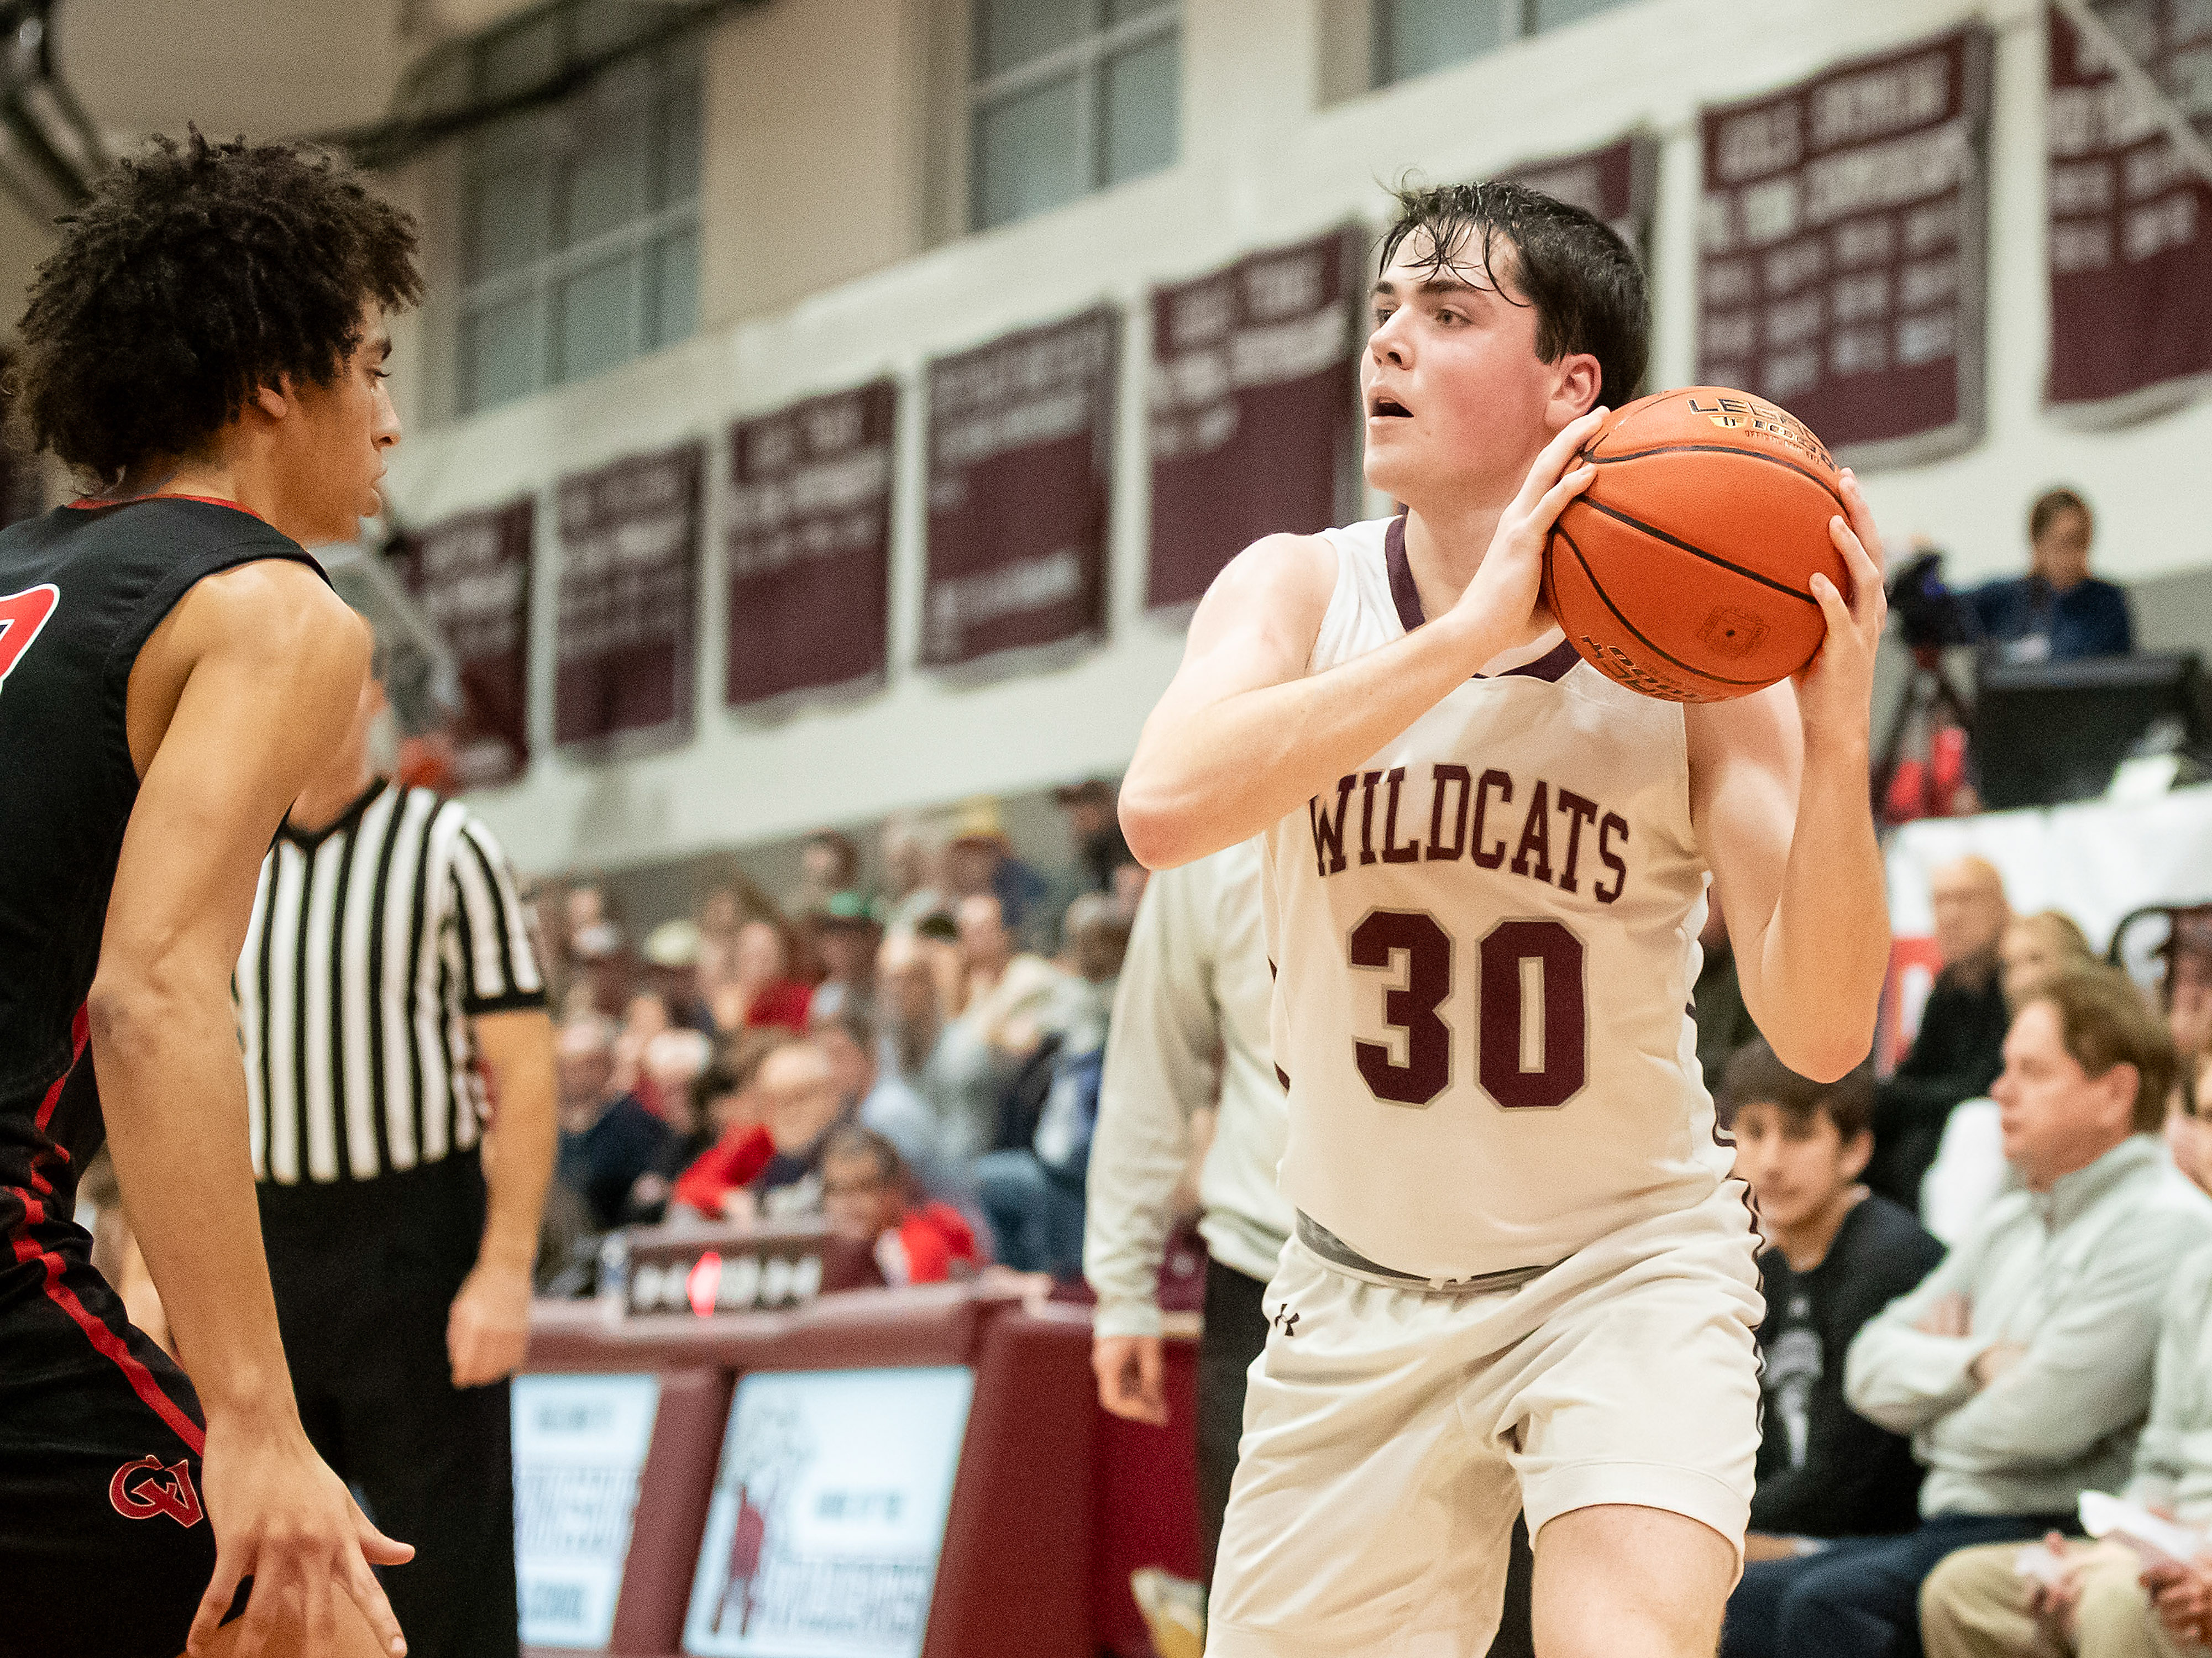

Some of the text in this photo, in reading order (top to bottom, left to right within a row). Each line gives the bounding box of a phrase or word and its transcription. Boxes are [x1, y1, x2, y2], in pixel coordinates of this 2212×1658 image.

[1309, 764, 1630, 904] WILDCATS
[1347, 907, 1590, 1111] 30
[109, 1454, 203, 1529] CV
